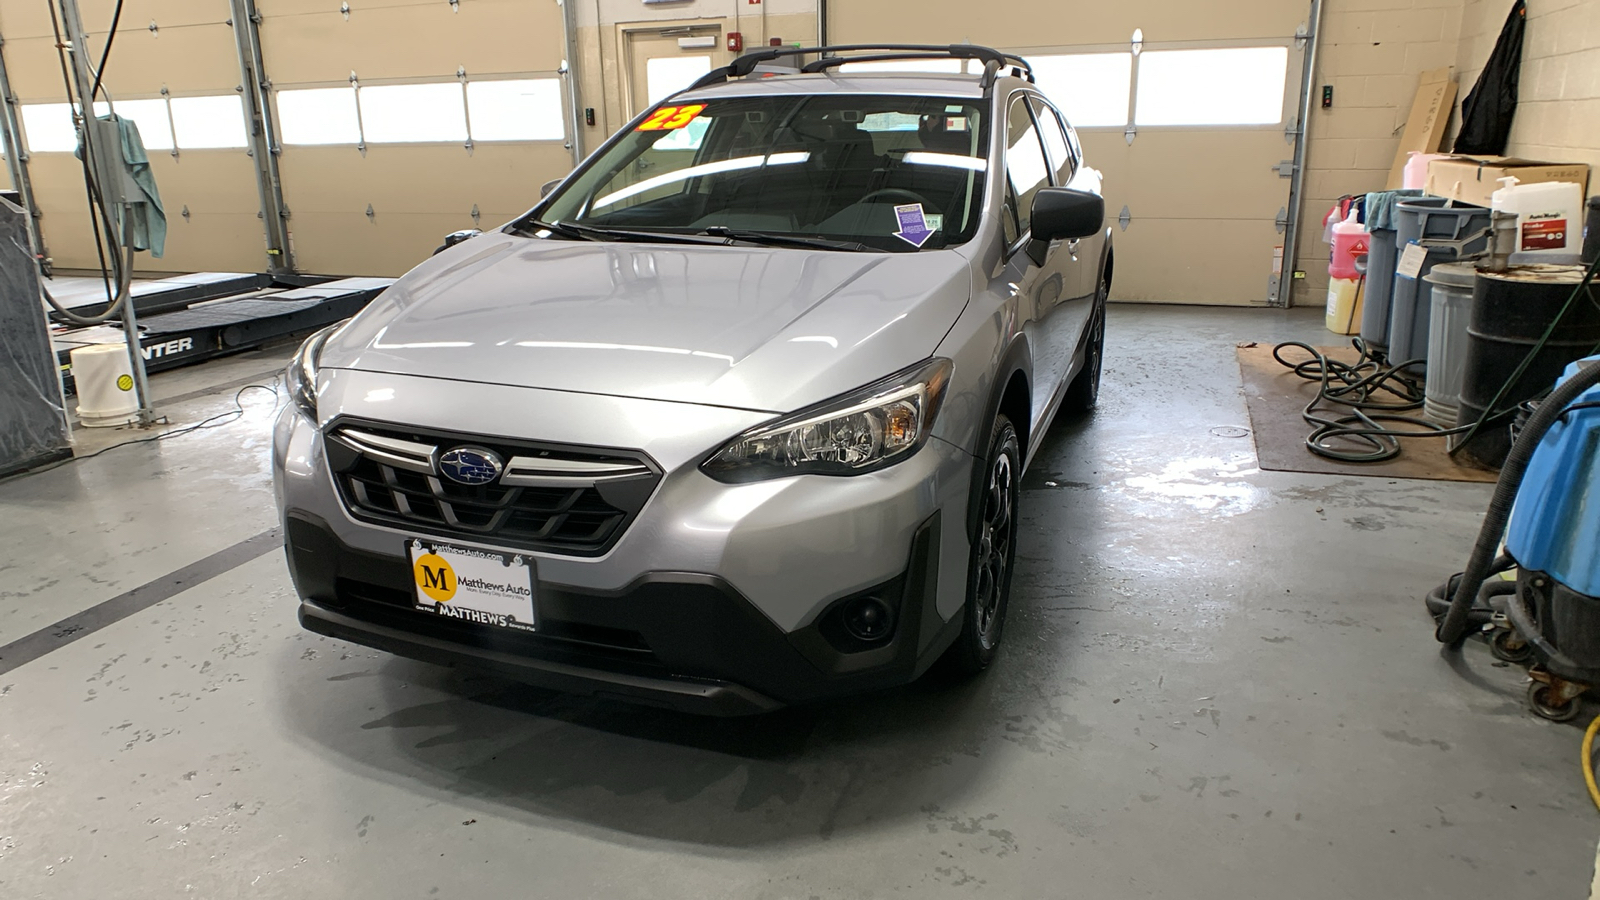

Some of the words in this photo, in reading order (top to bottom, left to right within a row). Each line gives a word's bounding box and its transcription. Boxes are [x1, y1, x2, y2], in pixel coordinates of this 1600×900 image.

[638, 104, 703, 130] 23
[431, 544, 503, 561] MatthewsAuto.com
[420, 564, 450, 592] M
[457, 575, 505, 592] Matthews
[505, 583, 531, 597] Auto
[439, 604, 508, 627] MATTHEWS
